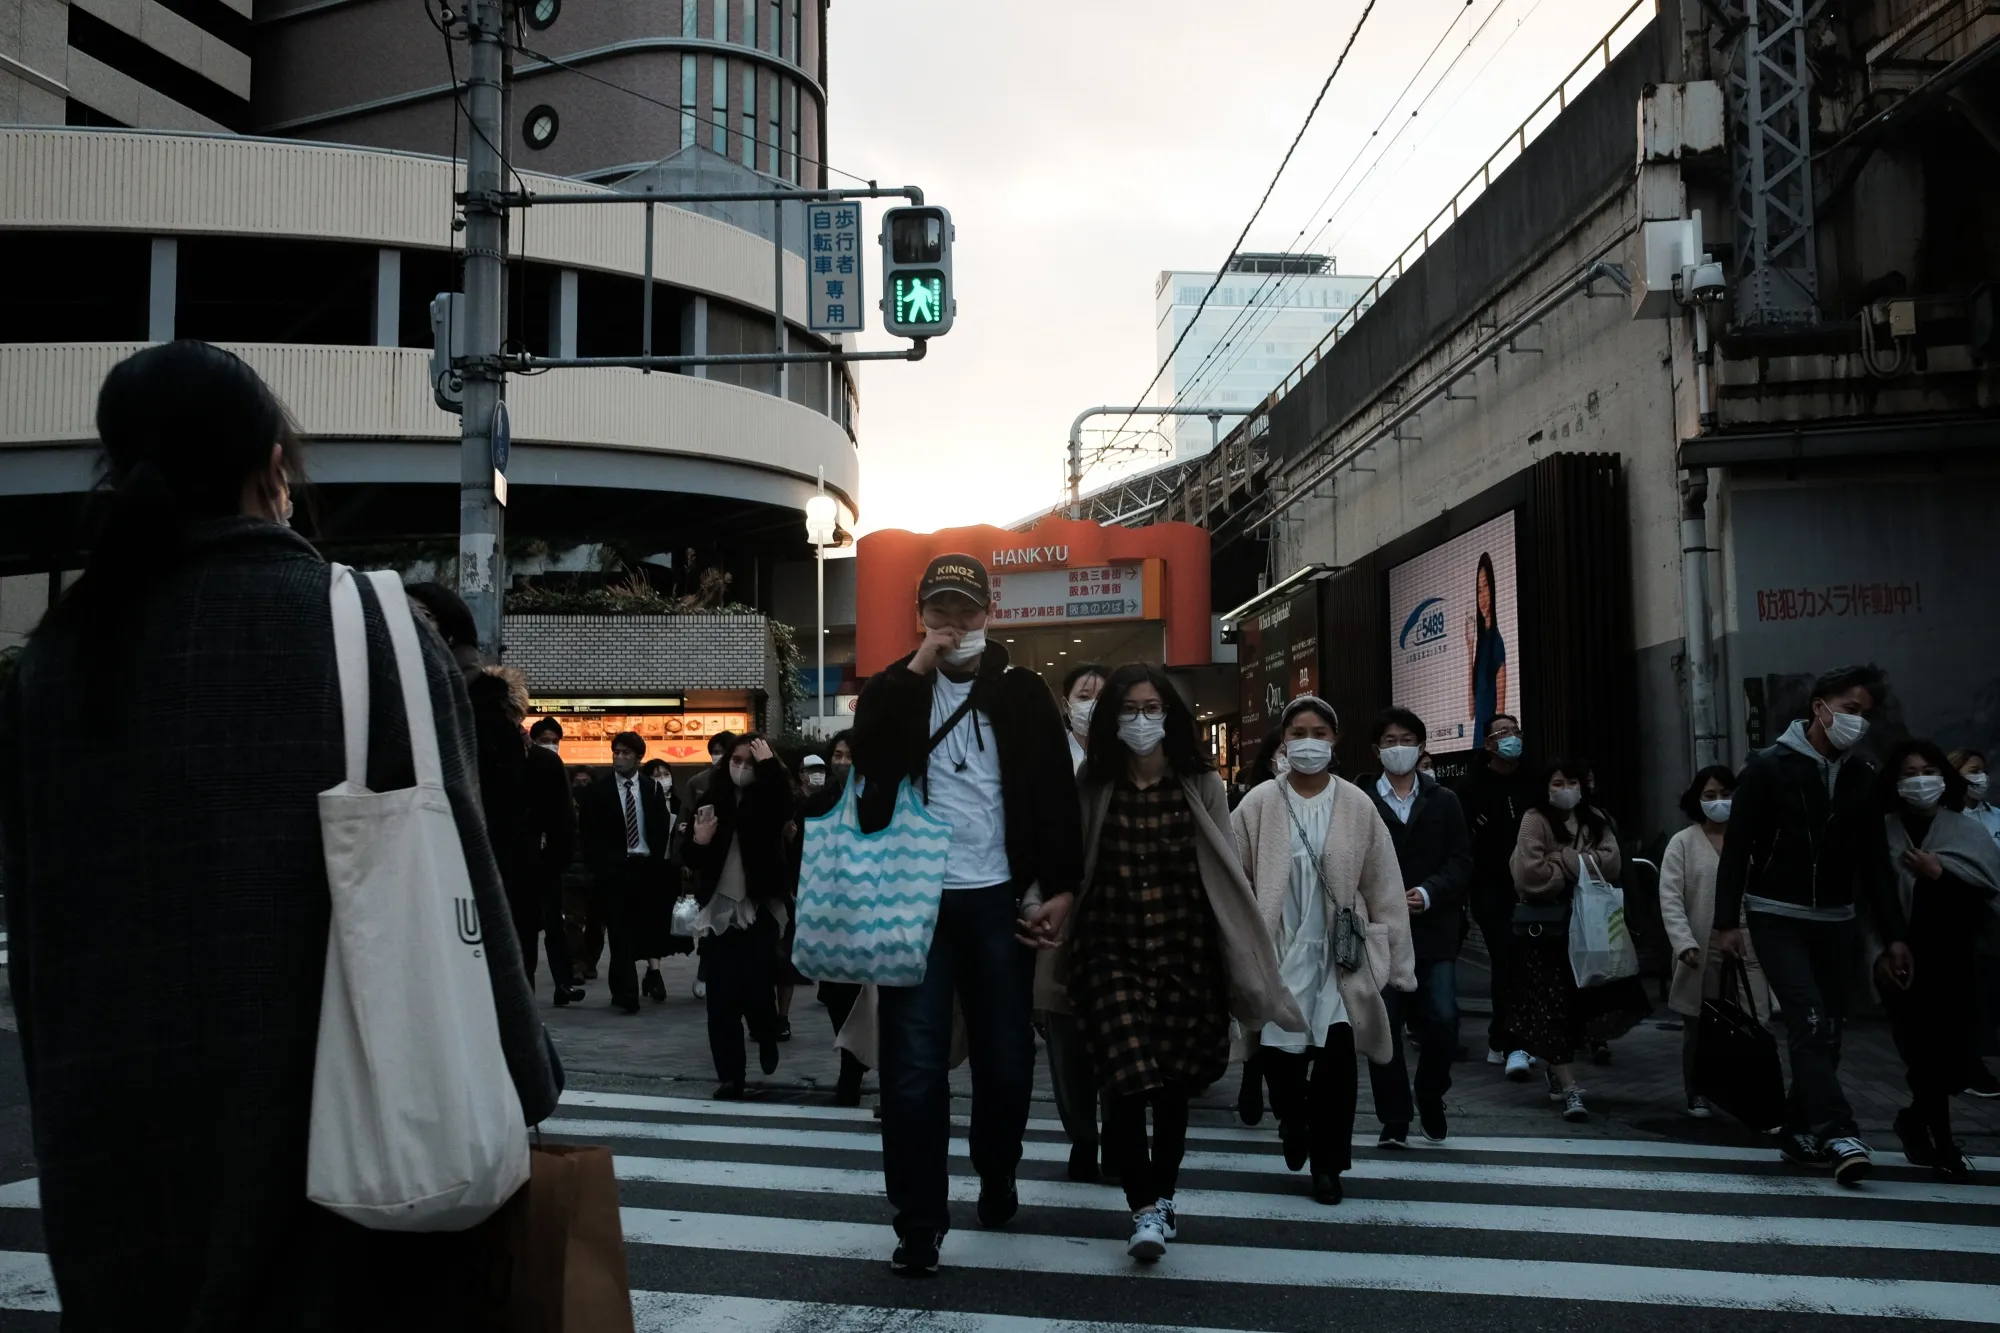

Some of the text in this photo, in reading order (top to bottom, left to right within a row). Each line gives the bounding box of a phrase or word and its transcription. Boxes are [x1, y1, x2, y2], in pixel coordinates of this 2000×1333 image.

[813, 210, 832, 275] 自転車
[835, 209, 854, 274] 歩行者
[825, 280, 845, 323] 専用
[992, 545, 1069, 566] HANKYU
[937, 565, 975, 579] KINGZ
[990, 577, 1002, 588] 街
[1069, 569, 1122, 582] 阪急三番街
[1069, 583, 1122, 597] 阪急17番街
[1069, 602, 1122, 615] 阪急のりば
[1757, 581, 1922, 622] 防犯カメラ作動中!
[1416, 611, 1444, 641] e5489
